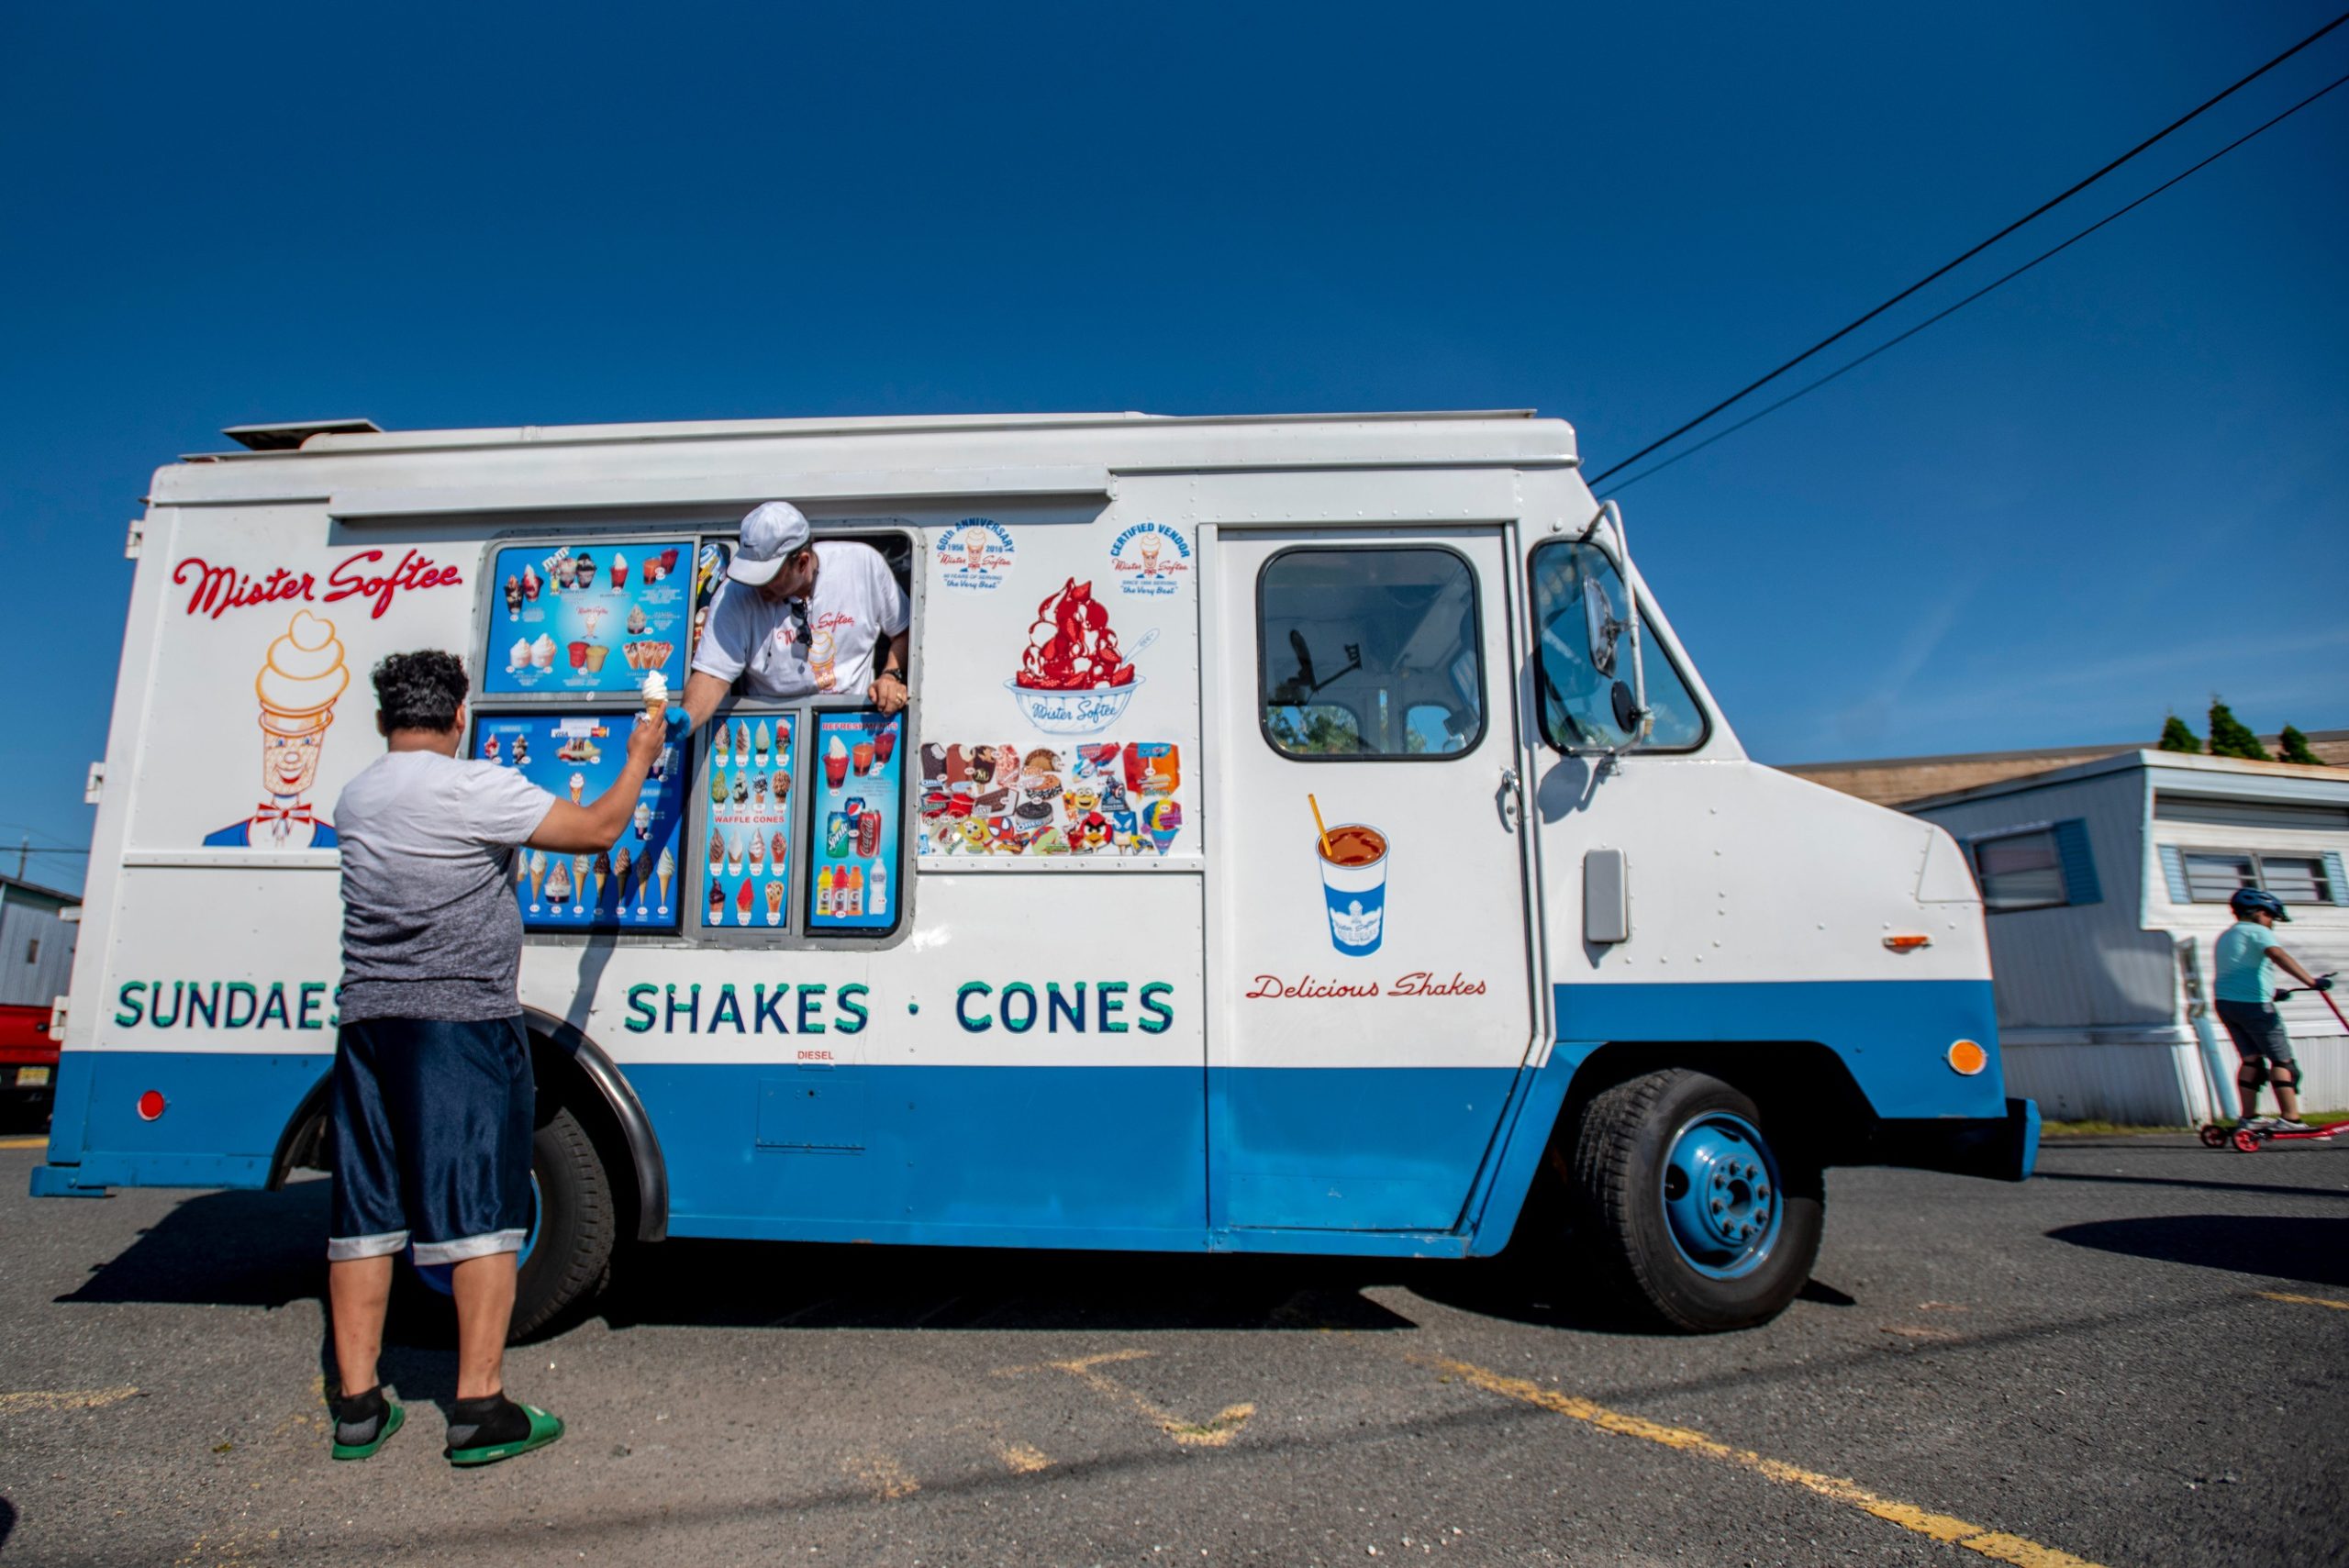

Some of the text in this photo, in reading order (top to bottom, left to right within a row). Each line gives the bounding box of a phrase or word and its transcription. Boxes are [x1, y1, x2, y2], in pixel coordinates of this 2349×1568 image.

[937, 517, 1015, 552] 60th ANNIVERSARY
[1110, 522, 1191, 558] CERTIFIED VENDOR
[937, 551, 1011, 570] Mister Softee
[1111, 558, 1188, 575] Mister Softee
[173, 549, 462, 619] Mister Softee
[961, 580, 977, 590] Very
[1138, 586, 1155, 596] Very
[818, 612, 854, 633] Softee
[1032, 700, 1118, 723] Mister Softee
[822, 722, 898, 730] REFRESHMENTS
[828, 822, 848, 851] Sprite
[1245, 972, 1487, 999] Delicious Shakes
[115, 981, 1174, 1034] SUNDAE SHAKES CONES
[797, 1051, 834, 1060] DIESEL
